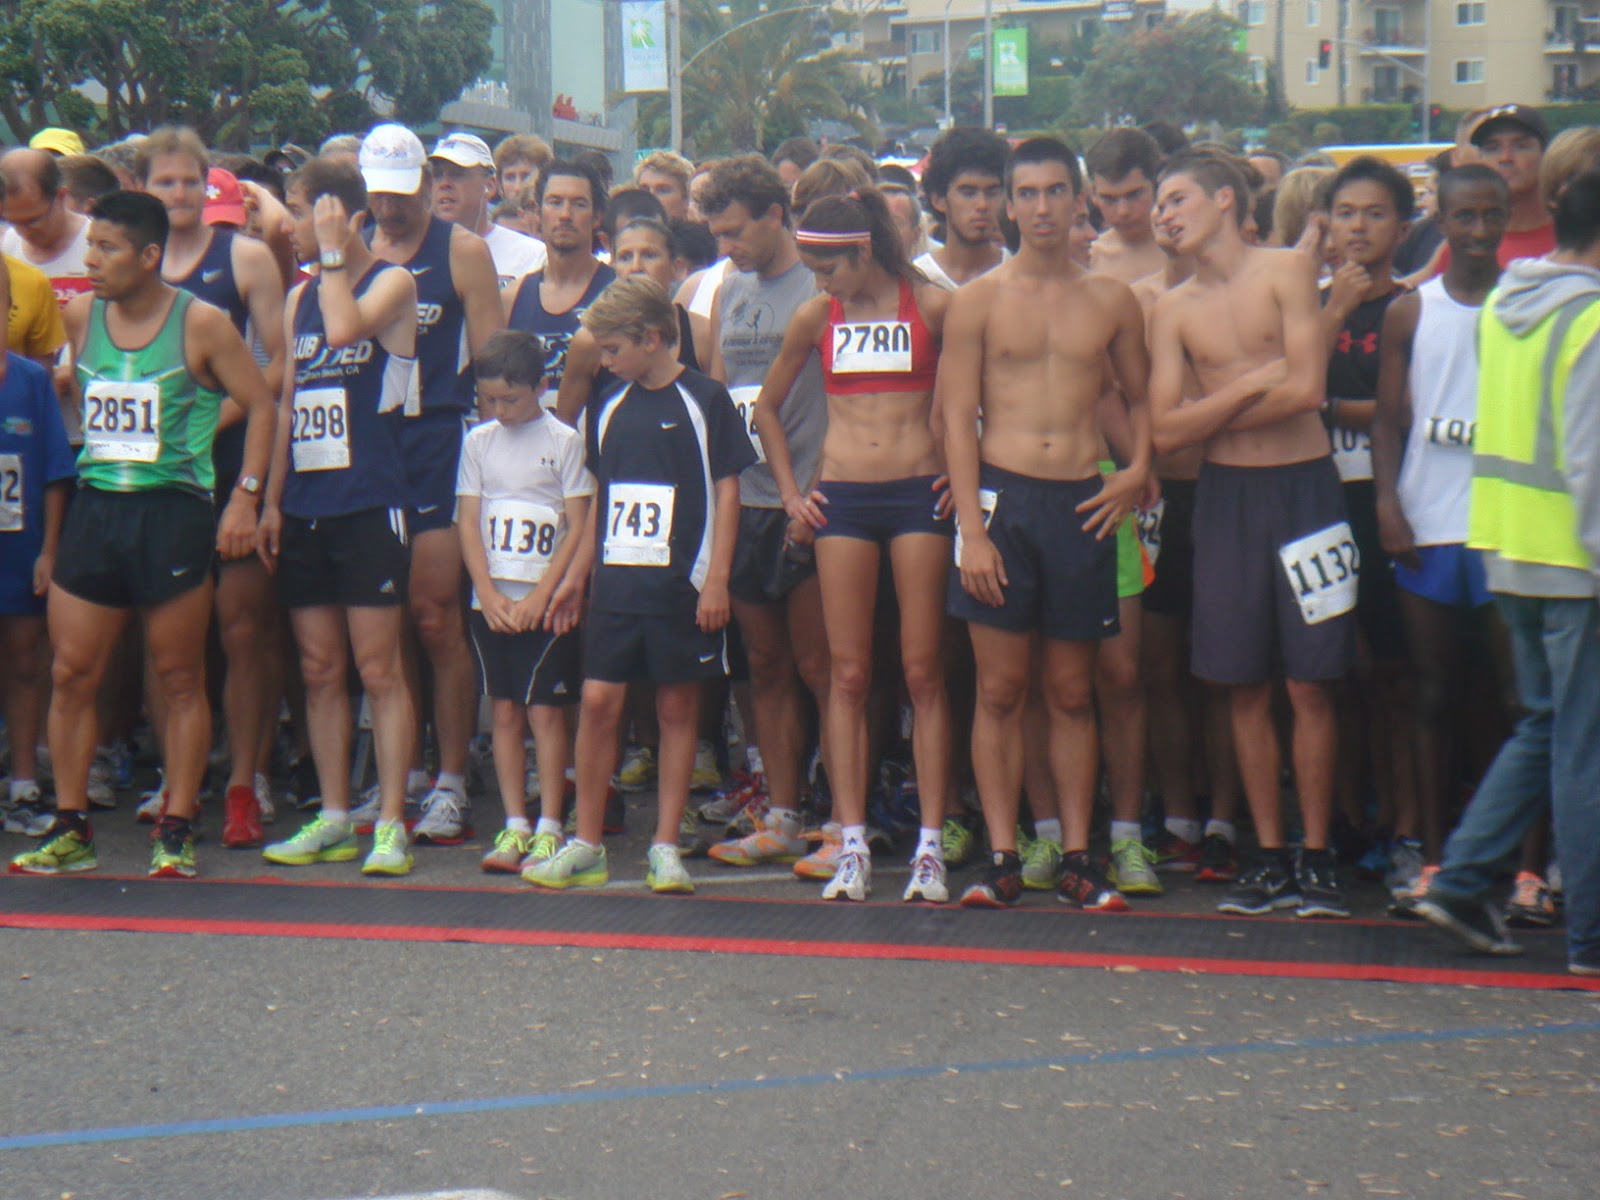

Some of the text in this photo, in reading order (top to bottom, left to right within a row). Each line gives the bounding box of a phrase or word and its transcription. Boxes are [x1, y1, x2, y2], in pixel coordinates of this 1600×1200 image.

[293, 334, 319, 359] LUB
[837, 324, 909, 354] 2780
[87, 395, 155, 434] 2851
[0, 469, 19, 502] 2
[489, 516, 556, 557] 1138
[613, 501, 662, 538] 743
[1290, 540, 1360, 596] 1132
